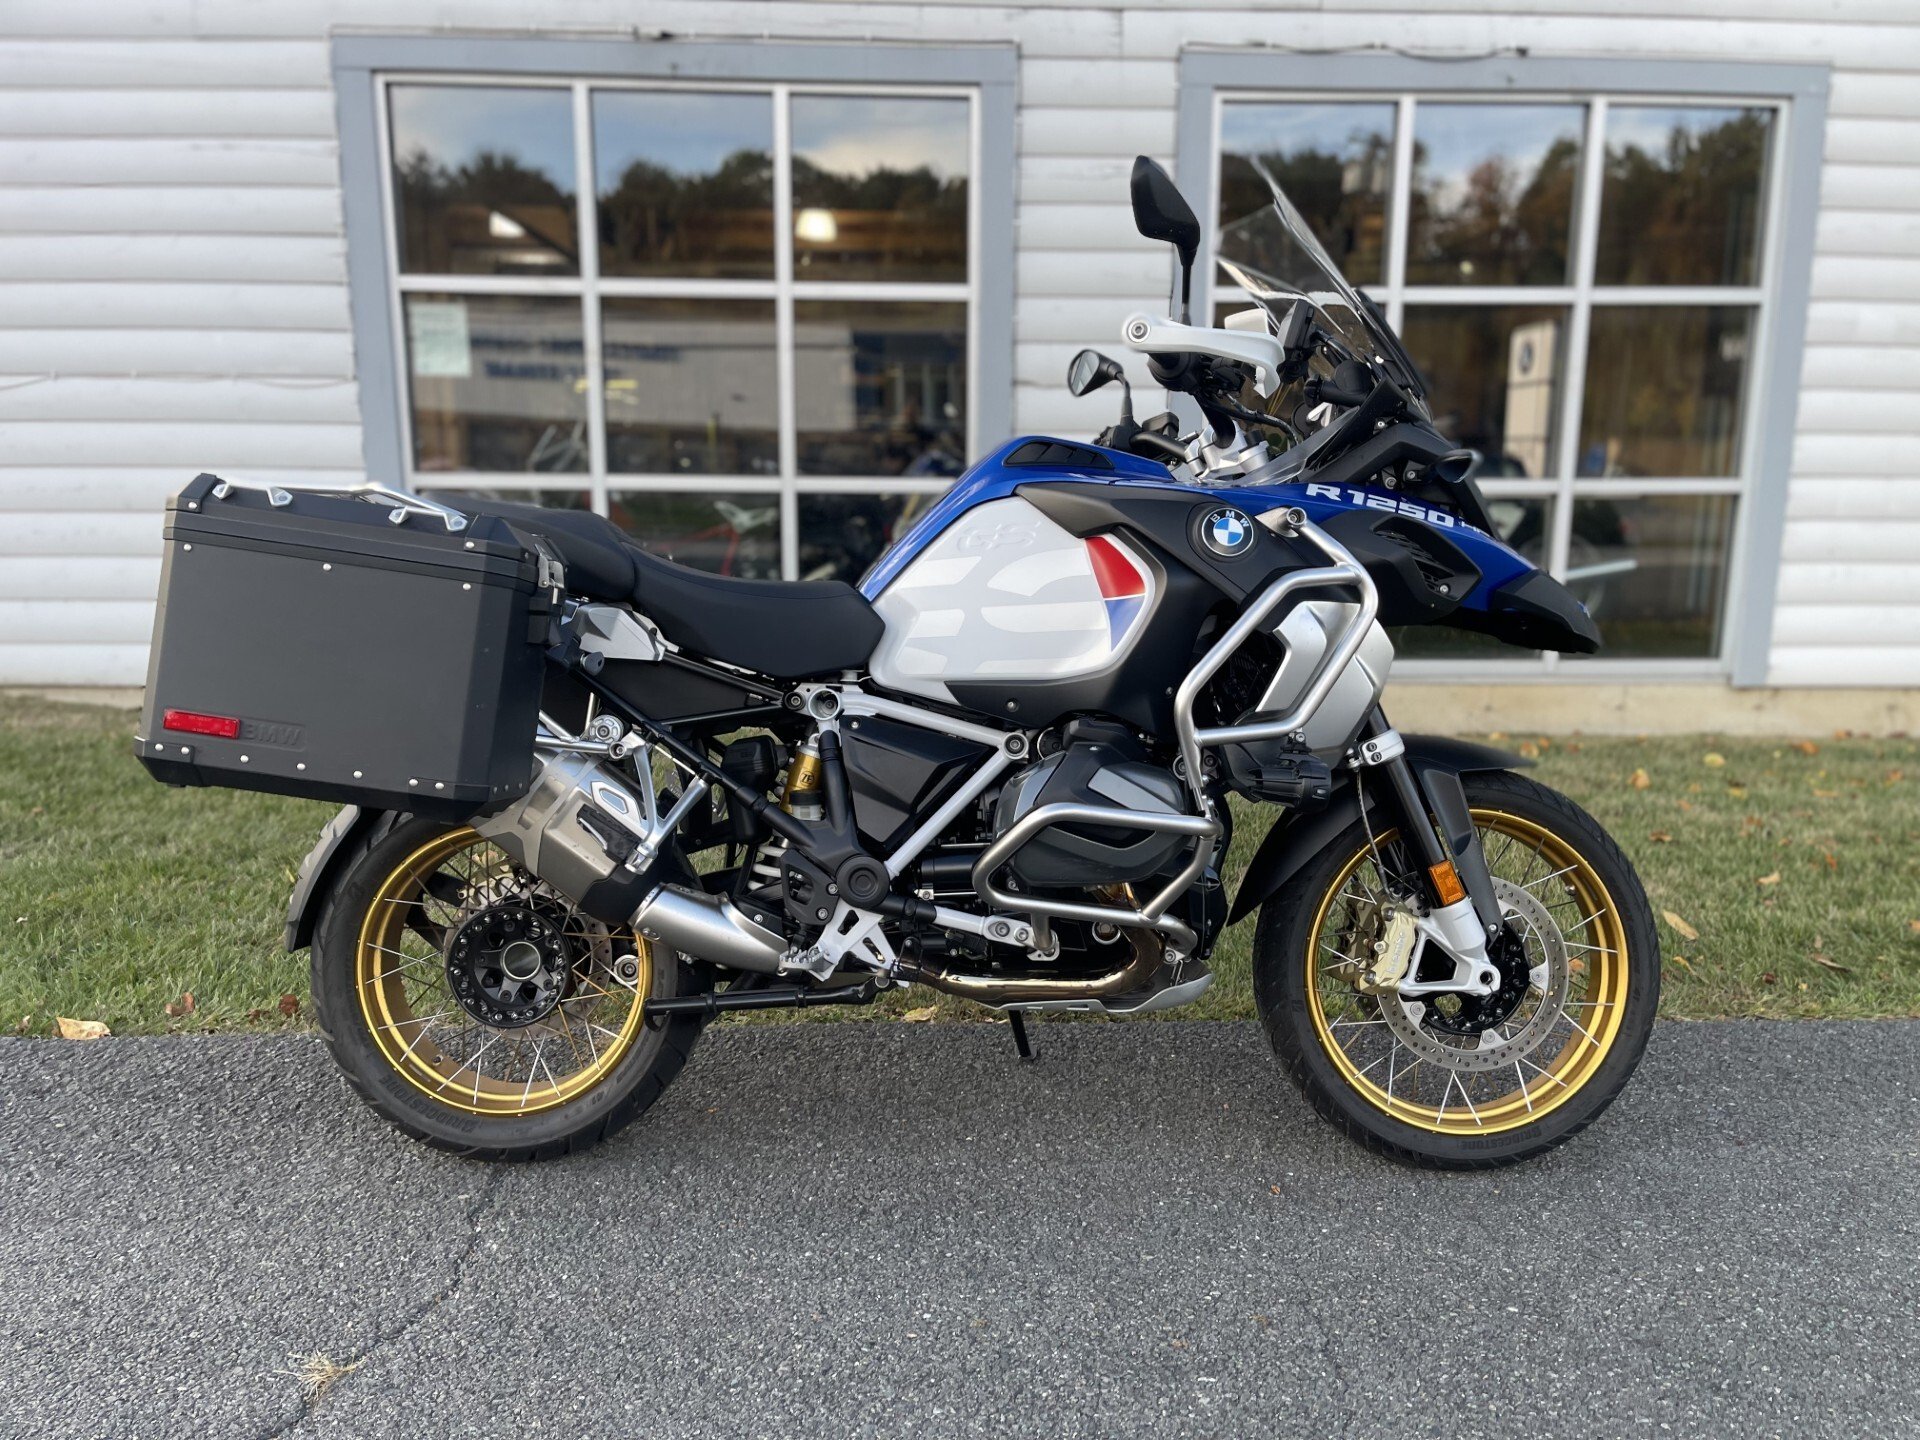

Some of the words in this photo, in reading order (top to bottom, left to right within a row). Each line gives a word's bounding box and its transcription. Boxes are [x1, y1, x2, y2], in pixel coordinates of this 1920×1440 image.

[1305, 483, 1342, 501] R
[1347, 489, 1455, 528] 1250
[1209, 509, 1250, 528] BMW
[245, 723, 301, 746] BMW
